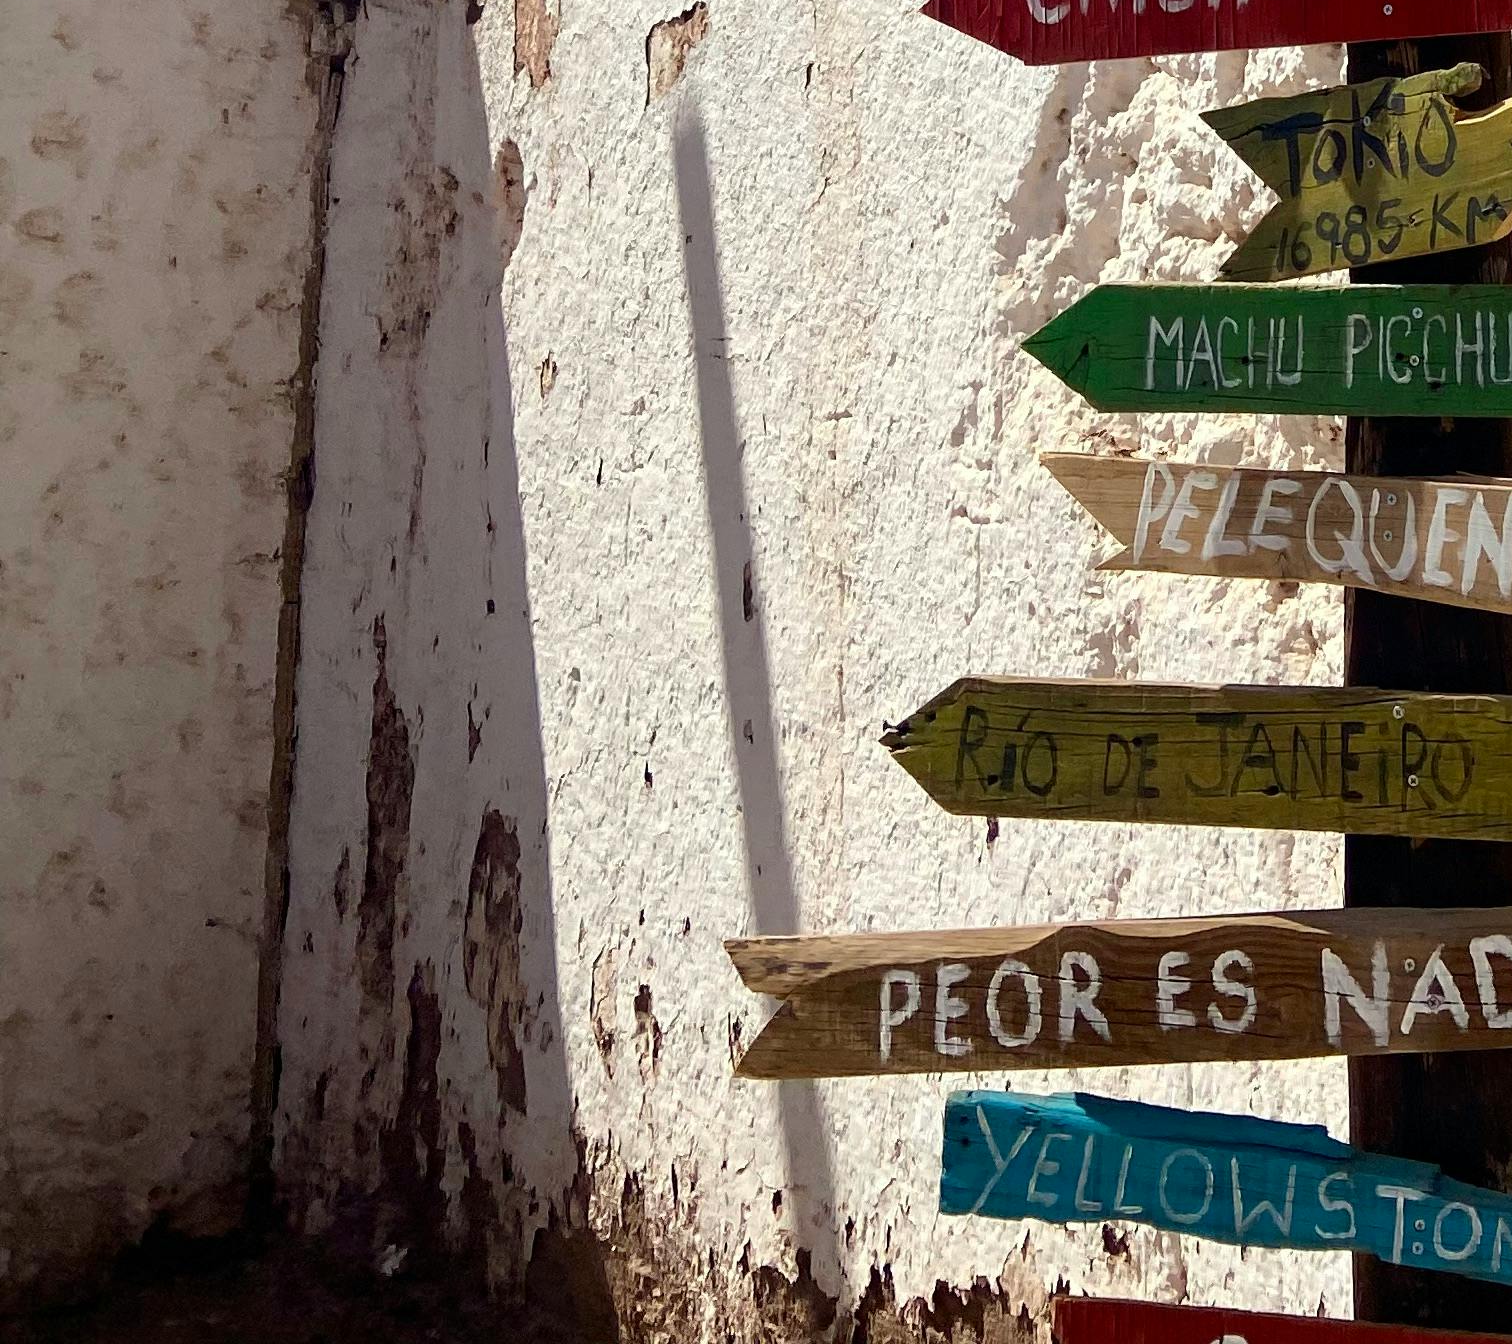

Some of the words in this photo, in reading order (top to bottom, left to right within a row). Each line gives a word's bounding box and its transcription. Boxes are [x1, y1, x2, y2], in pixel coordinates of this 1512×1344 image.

[1429, 191, 1509, 250] KM
[1145, 313, 1304, 391] MACHU
[1102, 732, 1160, 799] DE
[879, 950, 1112, 1064] PEOR
[1154, 949, 1259, 1035] ES
